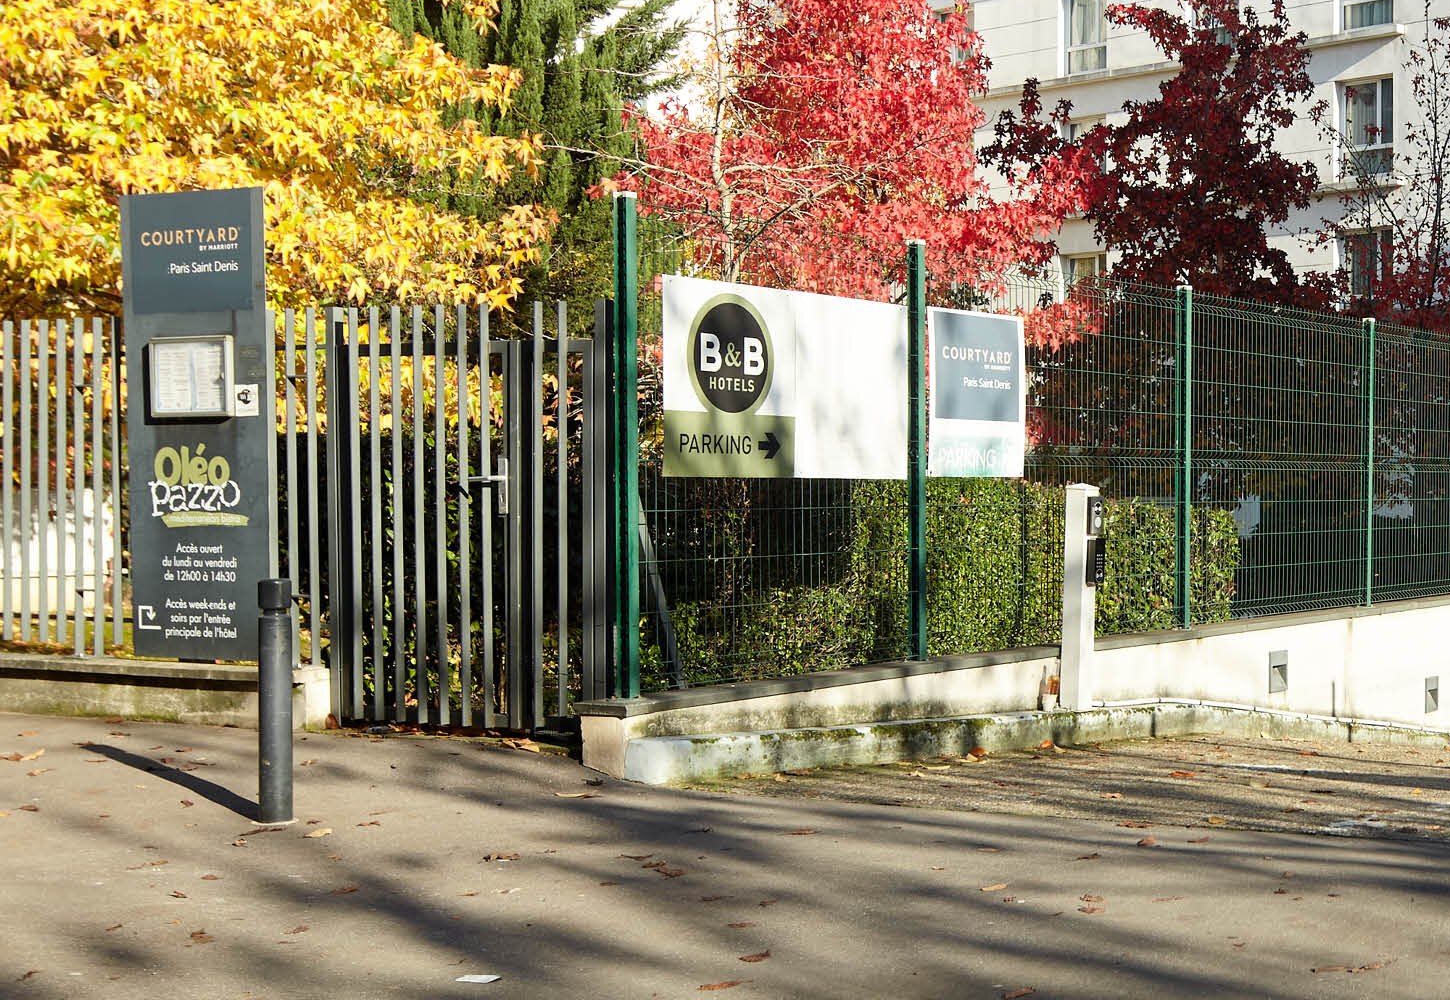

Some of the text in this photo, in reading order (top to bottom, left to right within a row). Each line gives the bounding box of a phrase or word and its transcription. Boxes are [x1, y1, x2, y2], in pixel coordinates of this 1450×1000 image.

[141, 226, 239, 246] COURTYARD
[170, 260, 239, 274] Paris Saint Denis
[700, 332, 765, 376] B&B
[942, 345, 1011, 364] COURTYARD
[709, 376, 755, 392] HOTELS
[963, 376, 1011, 390] Paris Saint Denis
[679, 433, 752, 455] PARKING
[154, 443, 230, 487] Oléo
[176, 542, 223, 553] Accès ouvert
[162, 555, 237, 568] du lundi au vendredi
[164, 570, 236, 582] de 12h00 à 14h30
[165, 598, 236, 610] Accès week-ends et
[170, 612, 231, 625] soirs par l'entrée
[165, 626, 237, 639] principale de l'hôtel
